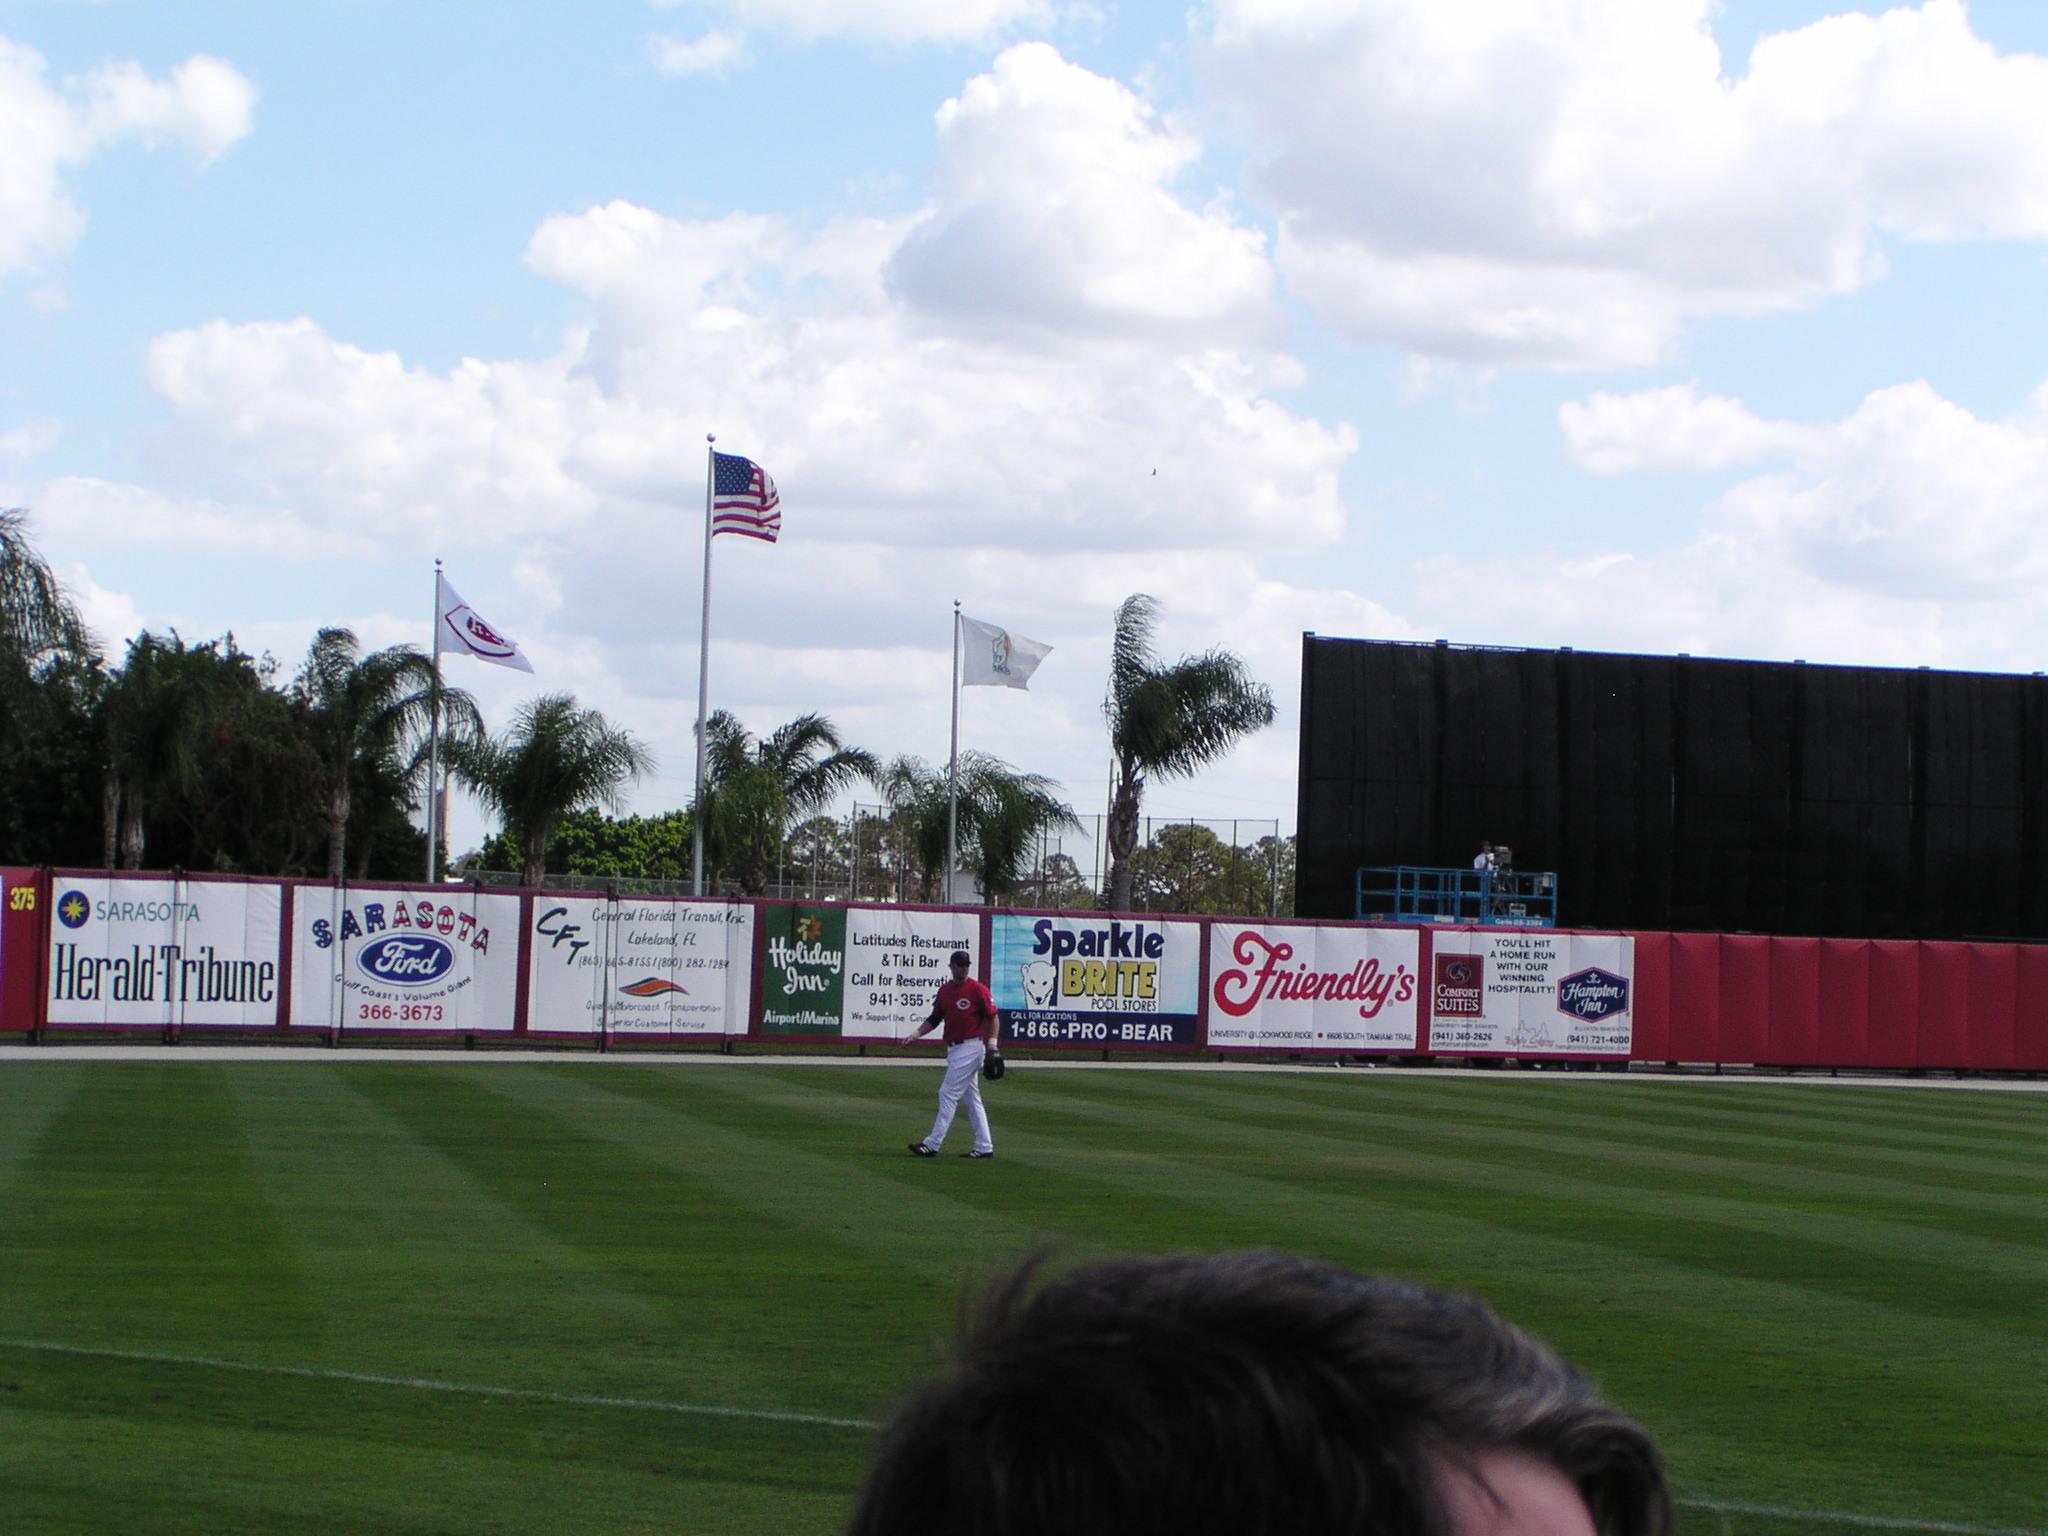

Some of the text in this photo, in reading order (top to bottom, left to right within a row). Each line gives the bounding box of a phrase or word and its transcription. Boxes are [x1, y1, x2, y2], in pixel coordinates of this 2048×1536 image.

[10, 887, 36, 911] 375
[96, 901, 200, 922] SARASOTA
[639, 908, 676, 922] Florida
[312, 901, 489, 956] SARASOTA
[683, 932, 697, 946] FL
[853, 933, 970, 950] Latitudes Restaurant
[1495, 938, 1551, 948] YOU'LL HIT
[375, 941, 440, 974] Ford
[769, 936, 842, 974] Holiday
[882, 954, 940, 968] & Tiki Bar
[1033, 919, 1165, 1006] Sparkle
[1490, 950, 1556, 960] A HOME RUN
[54, 943, 274, 1003] Herald-Tribune
[1214, 930, 1415, 1019] Friendly's
[1497, 962, 1548, 971] WITH OUR
[783, 966, 827, 995] Inn
[851, 973, 874, 986] Call
[879, 973, 893, 986] for
[1062, 960, 1157, 998] BRITE
[1499, 974, 1545, 982] WINNING
[403, 990, 446, 1001] Volume
[1562, 982, 1624, 1002] Hampton
[360, 1004, 443, 1021] 366-3673
[1091, 998, 1156, 1012] POOL STORES
[1437, 999, 1480, 1012] SUITES
[1575, 999, 1607, 1015] Inn
[763, 1009, 840, 1026] Airport/Marina
[1432, 1032, 1453, 1041] (941)
[1567, 1035, 1588, 1044] (941)
